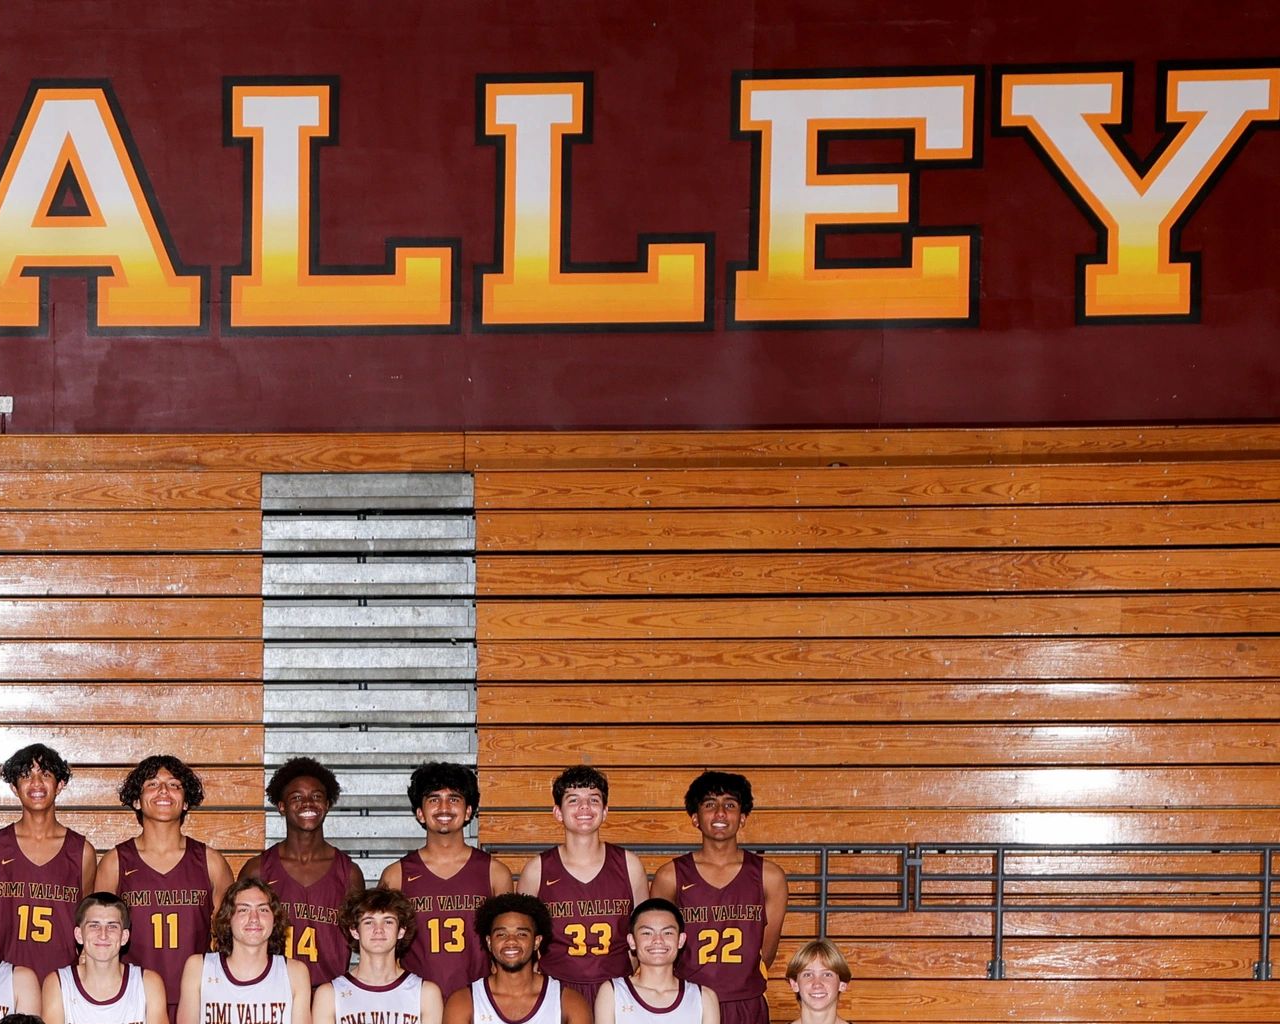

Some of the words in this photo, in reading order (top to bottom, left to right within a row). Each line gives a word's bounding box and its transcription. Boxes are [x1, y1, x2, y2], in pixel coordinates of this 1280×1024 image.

[29, 883, 79, 903] VALLEY
[156, 889, 207, 906] VALLEY
[576, 899, 630, 917] VALLEY
[18, 905, 53, 942] 15
[711, 905, 762, 922] VALLEY
[151, 913, 179, 949] 11
[287, 926, 318, 962] 14
[427, 917, 466, 953] 13
[564, 923, 612, 956] 33
[698, 928, 743, 965] 22
